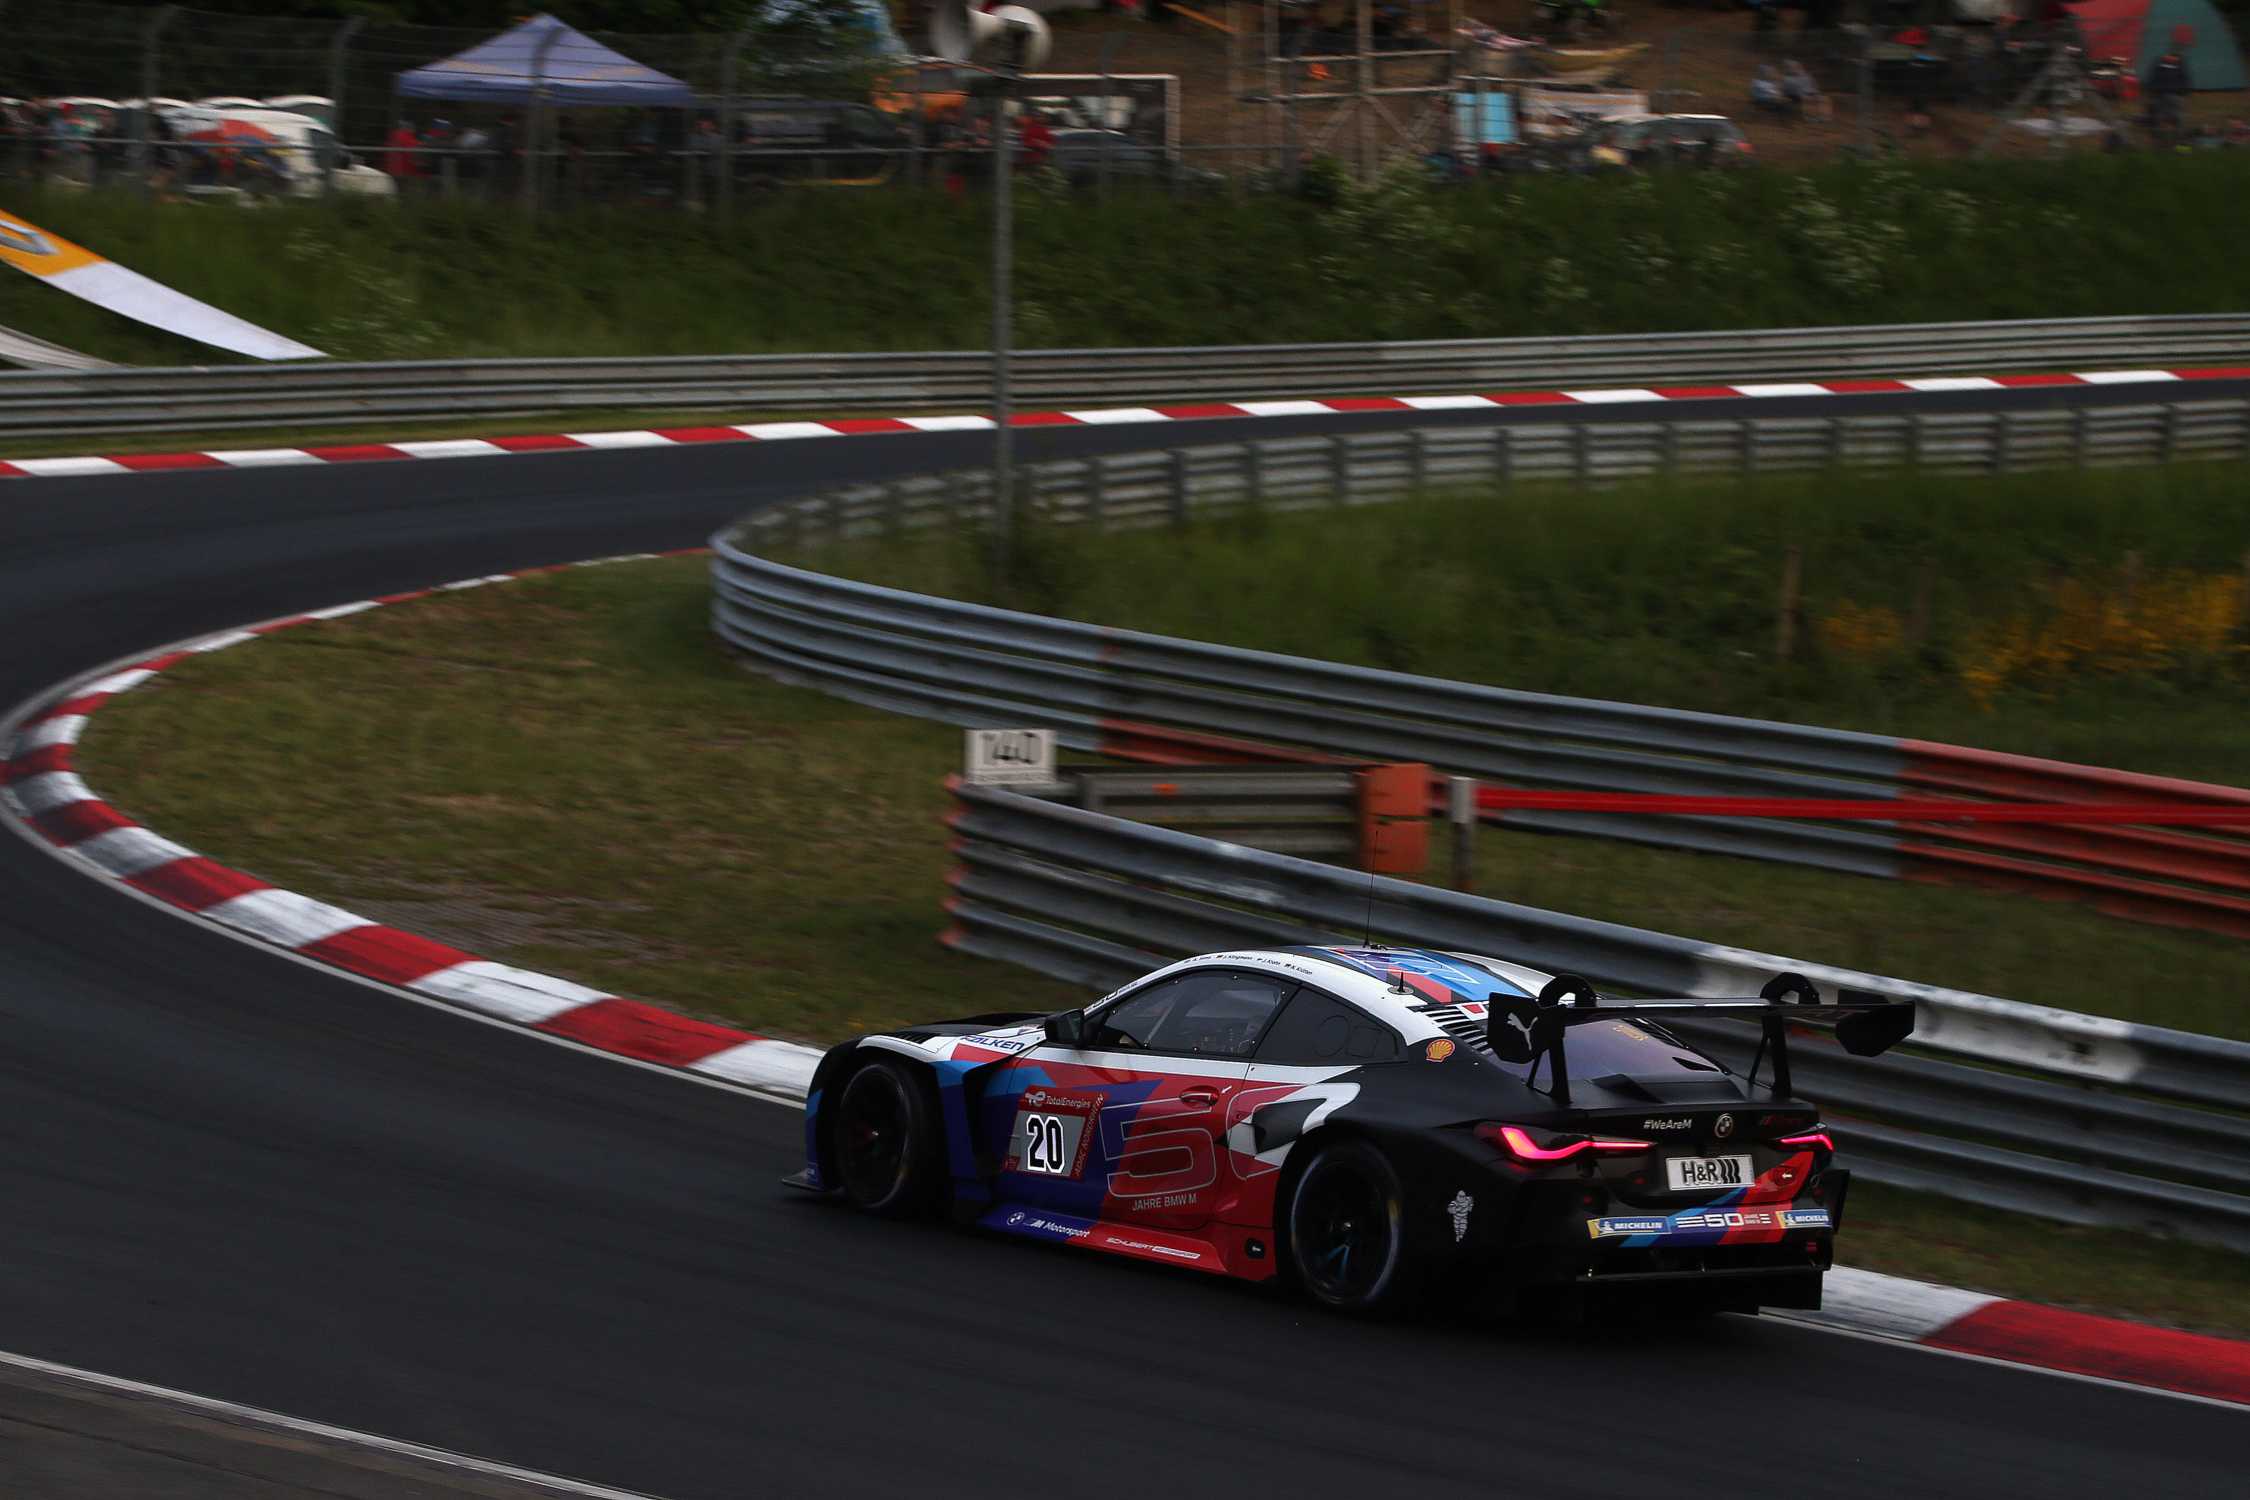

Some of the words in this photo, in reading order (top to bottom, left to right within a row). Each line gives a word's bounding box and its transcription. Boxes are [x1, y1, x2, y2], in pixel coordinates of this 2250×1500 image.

[960, 1035, 1025, 1051] FALKEN
[1045, 1094, 1091, 1109] TotalEnergies
[1643, 1118, 1693, 1131] #WeAreM
[1026, 1114, 1065, 1174] 20
[1132, 1197, 1163, 1212] JAHRE
[1164, 1194, 1187, 1208] BMW
[1187, 1192, 1198, 1205] M
[1613, 1220, 1664, 1231] MICHELIN
[1704, 1212, 1745, 1228] 50
[1794, 1214, 1830, 1223] MICHELIN
[1045, 1221, 1090, 1239] Motorsport
